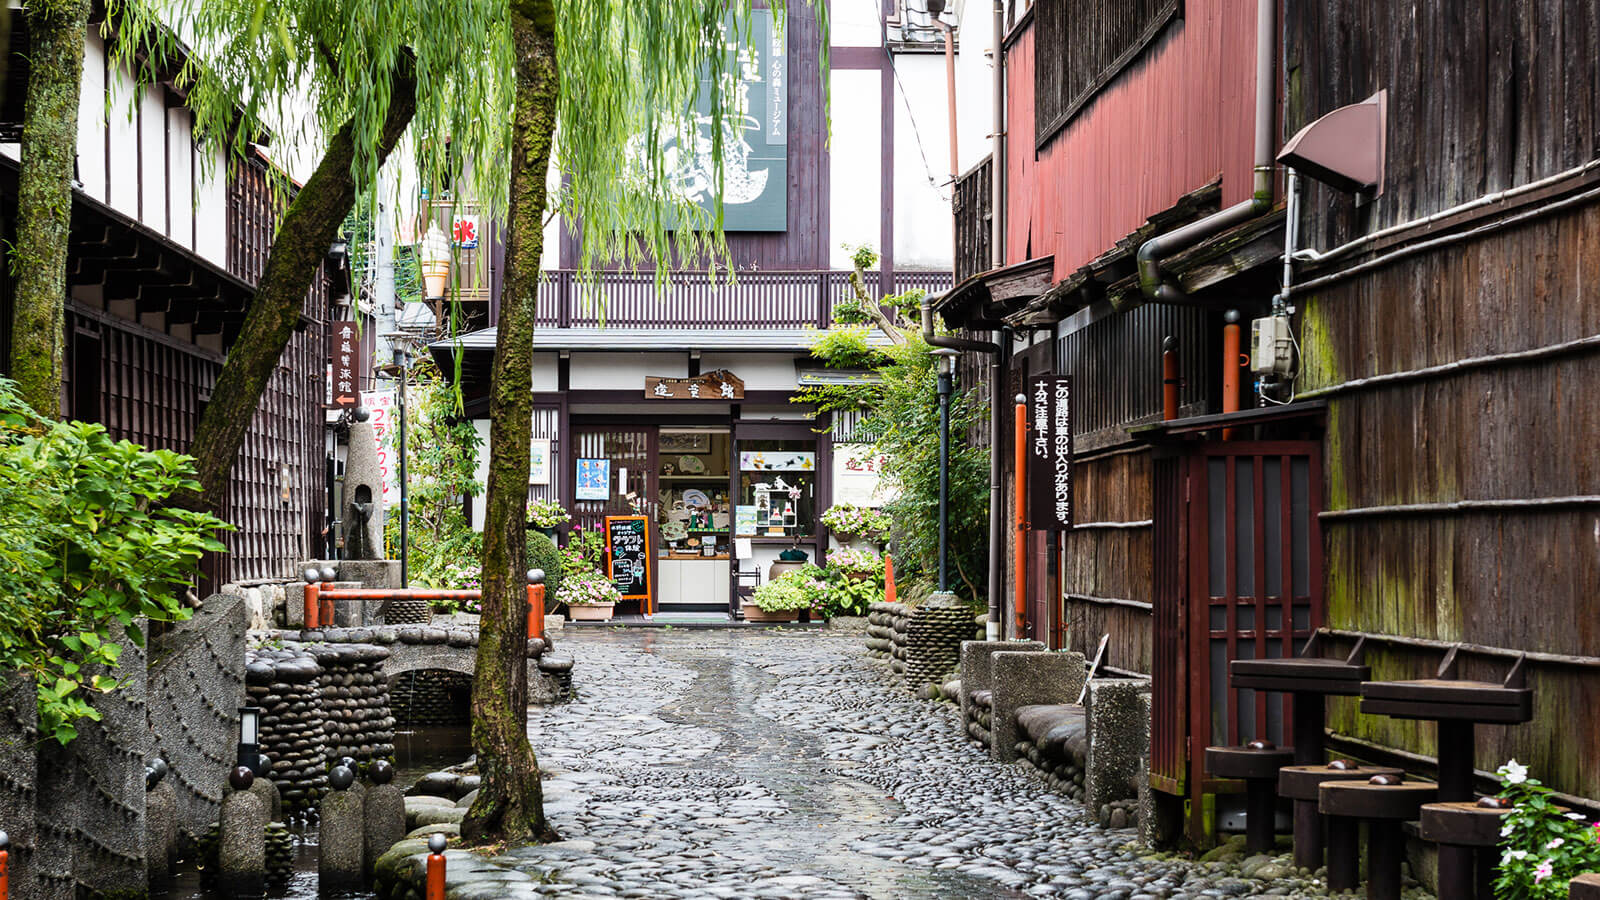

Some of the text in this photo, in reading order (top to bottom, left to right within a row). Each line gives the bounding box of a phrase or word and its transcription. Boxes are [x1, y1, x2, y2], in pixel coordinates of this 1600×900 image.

[453, 219, 475, 242] 氷
[1035, 380, 1048, 458] 十分ご注意下さい。
